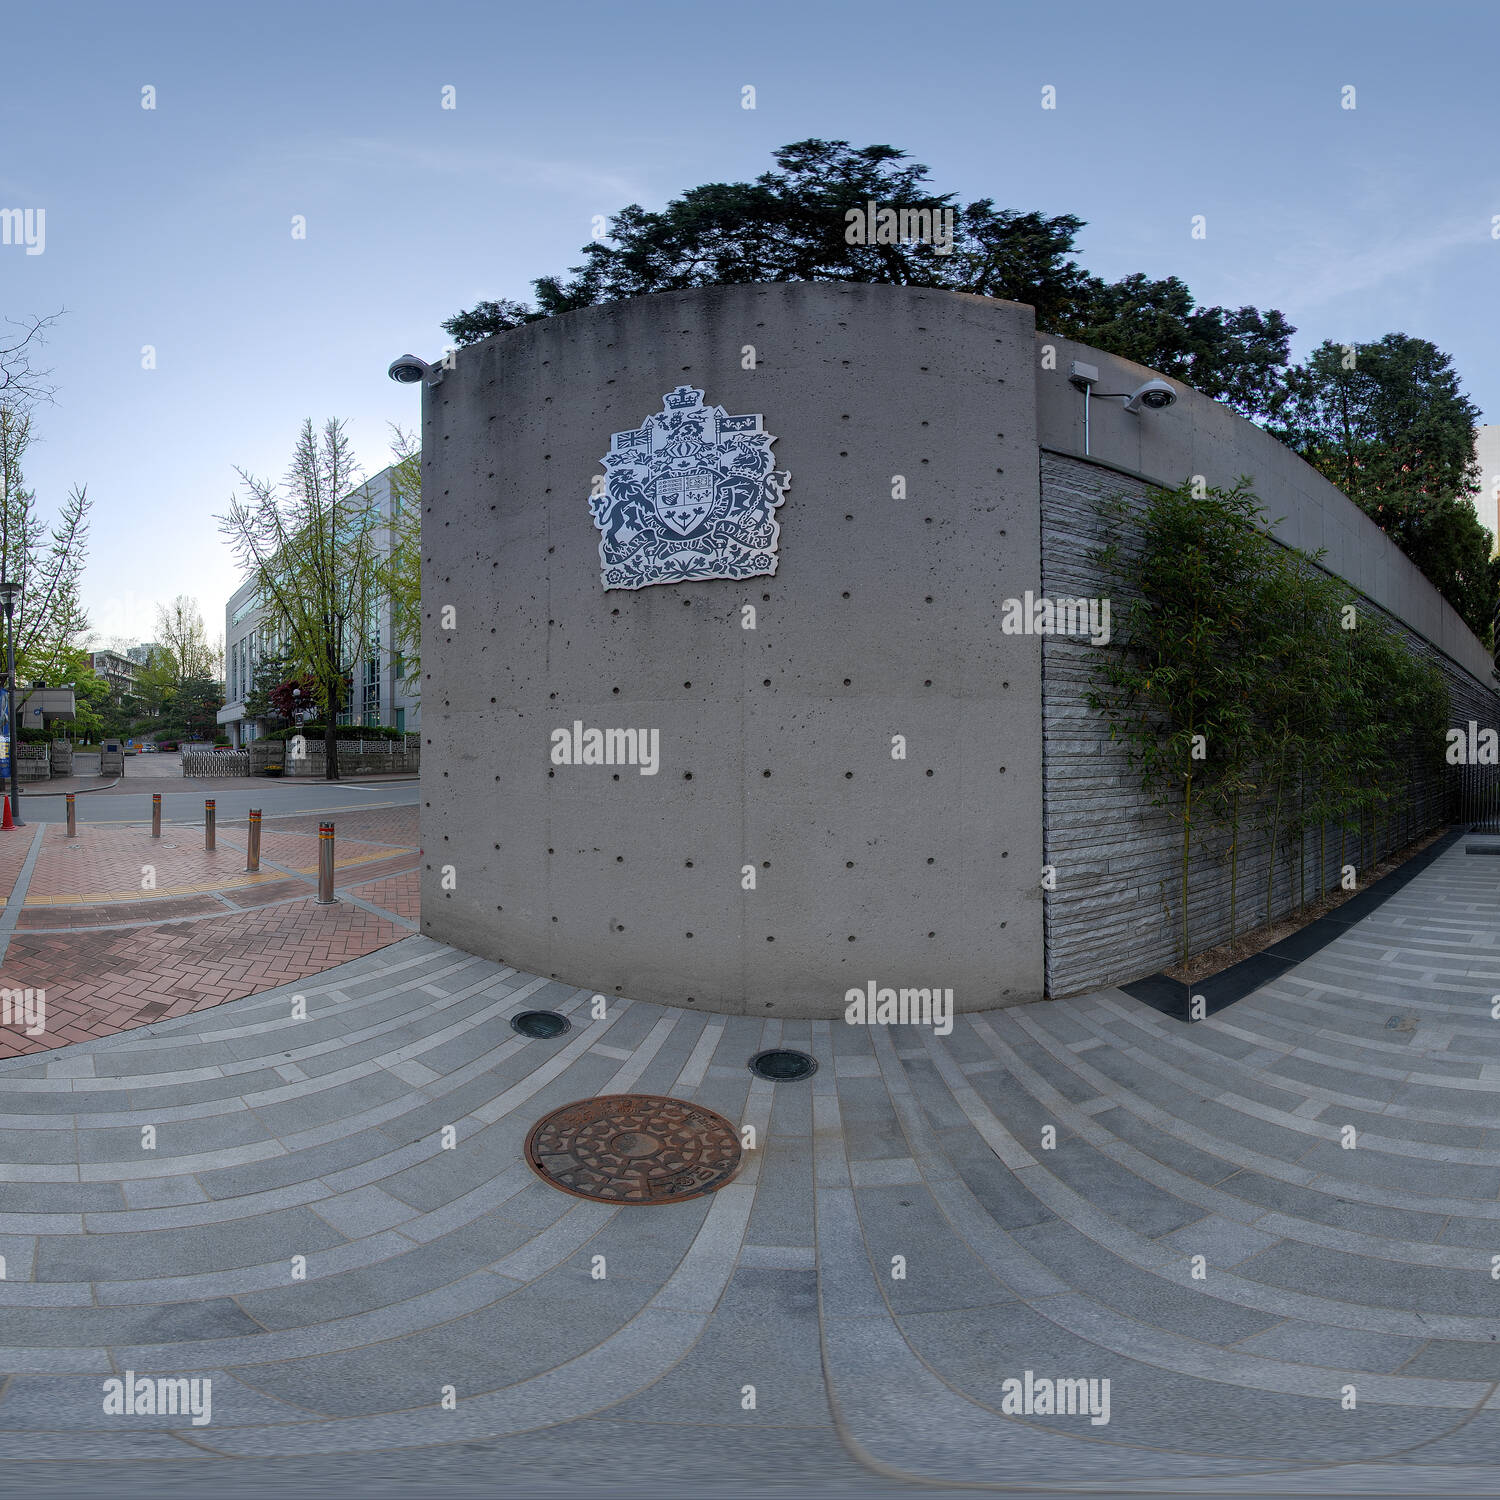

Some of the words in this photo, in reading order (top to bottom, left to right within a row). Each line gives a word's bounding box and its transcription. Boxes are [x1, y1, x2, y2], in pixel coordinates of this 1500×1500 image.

[619, 533, 649, 560] MARI
[667, 540, 704, 553] USQUE
[717, 522, 736, 534] AD
[733, 529, 768, 549] MARE
